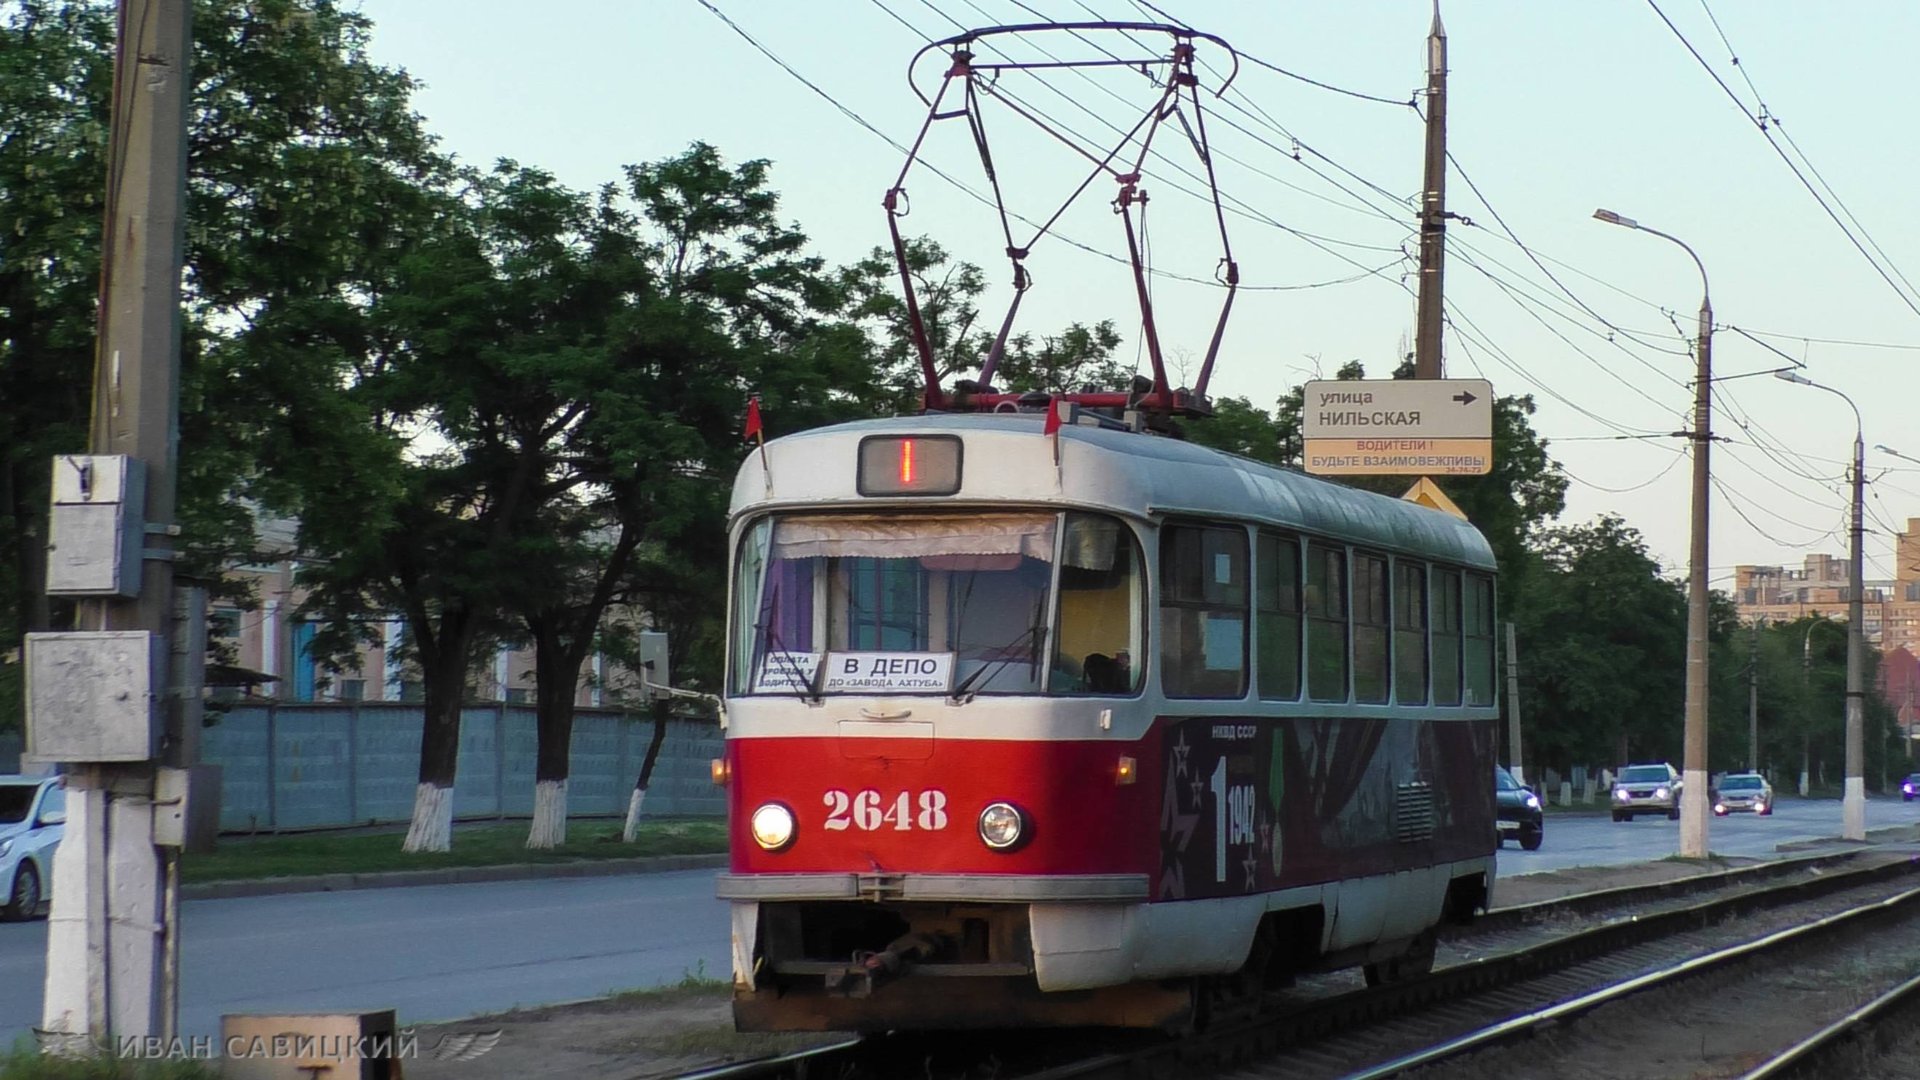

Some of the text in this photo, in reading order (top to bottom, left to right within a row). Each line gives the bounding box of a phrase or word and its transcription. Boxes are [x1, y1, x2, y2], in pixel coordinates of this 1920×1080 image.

[1320, 392, 1373, 407] улица
[1319, 411, 1421, 426] НИЛЬСКАЯ
[902, 440, 914, 482] 1
[1312, 456, 1485, 467] БУДЬТЕ ВЗАИМОВЕЖЛИВЫ
[844, 659, 937, 677] В ДЕПО
[828, 678, 943, 687] ДО «ЗАВОДА АХТУБА»
[822, 789, 949, 831] 2648
